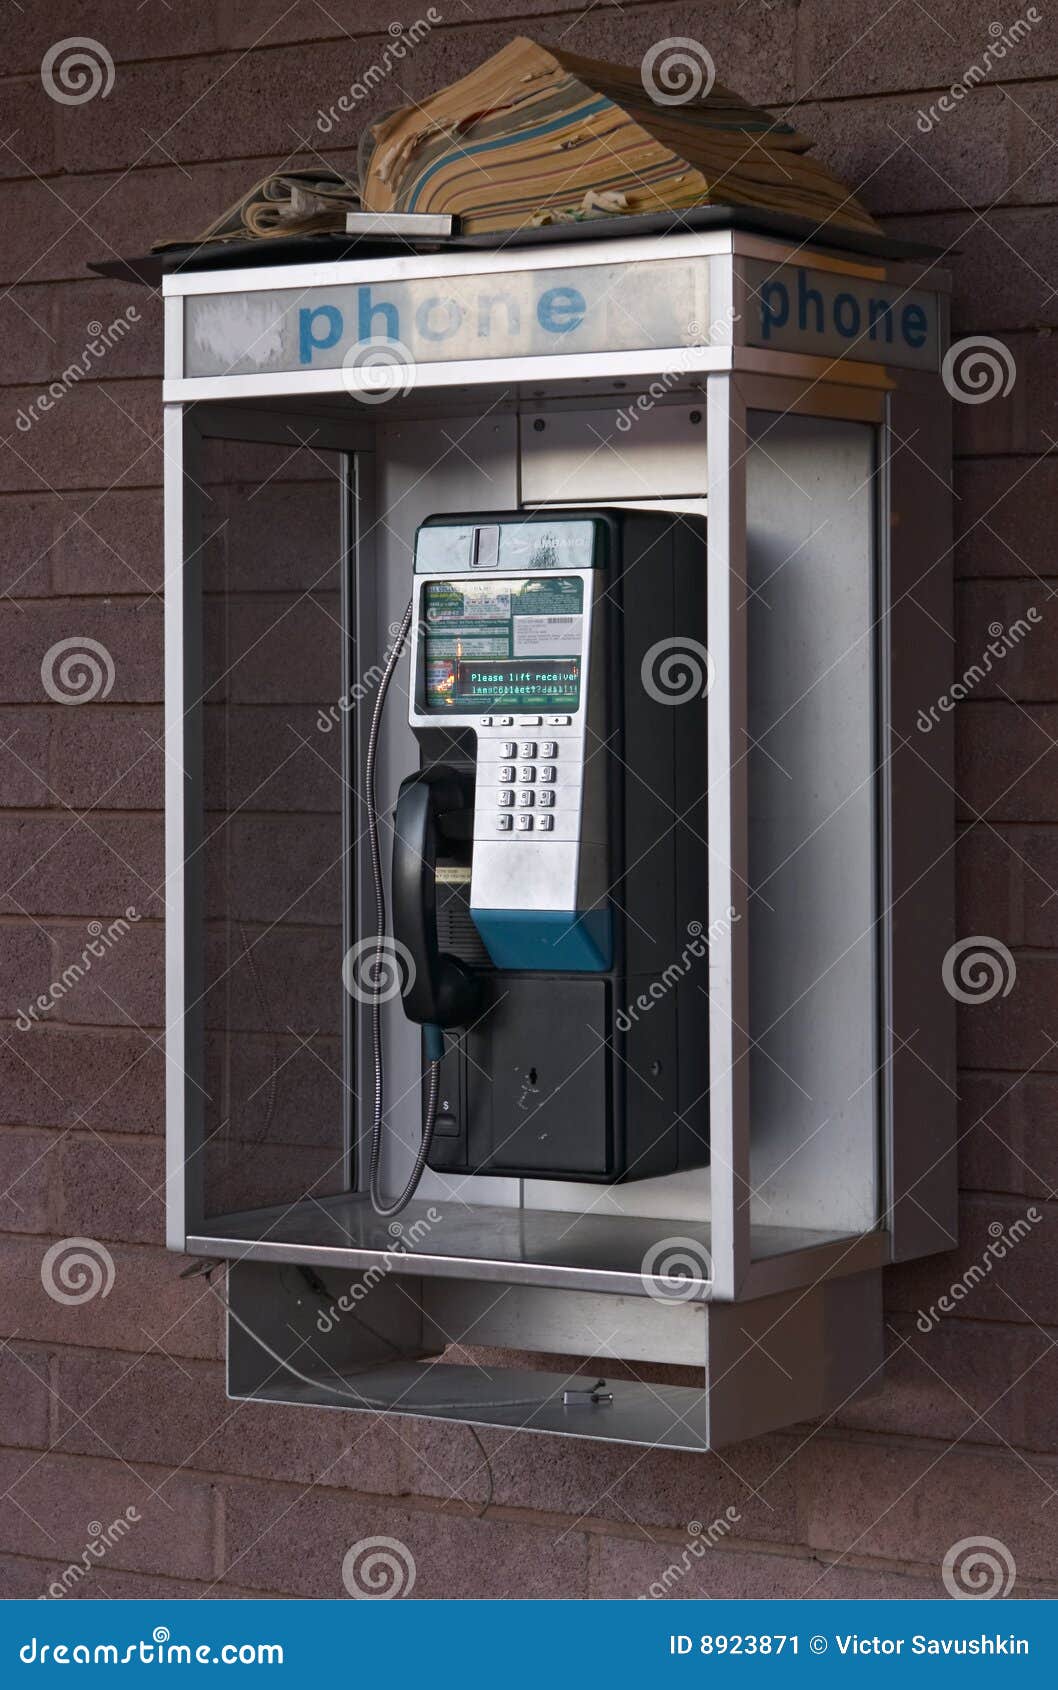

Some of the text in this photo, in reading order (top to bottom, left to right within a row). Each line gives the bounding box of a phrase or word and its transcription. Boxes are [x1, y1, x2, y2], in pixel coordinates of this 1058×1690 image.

[299, 286, 587, 364] phone
[760, 270, 928, 348] phone
[471, 673, 504, 682] Please
[510, 673, 531, 682] lift
[443, 1101, 449, 1111] $
